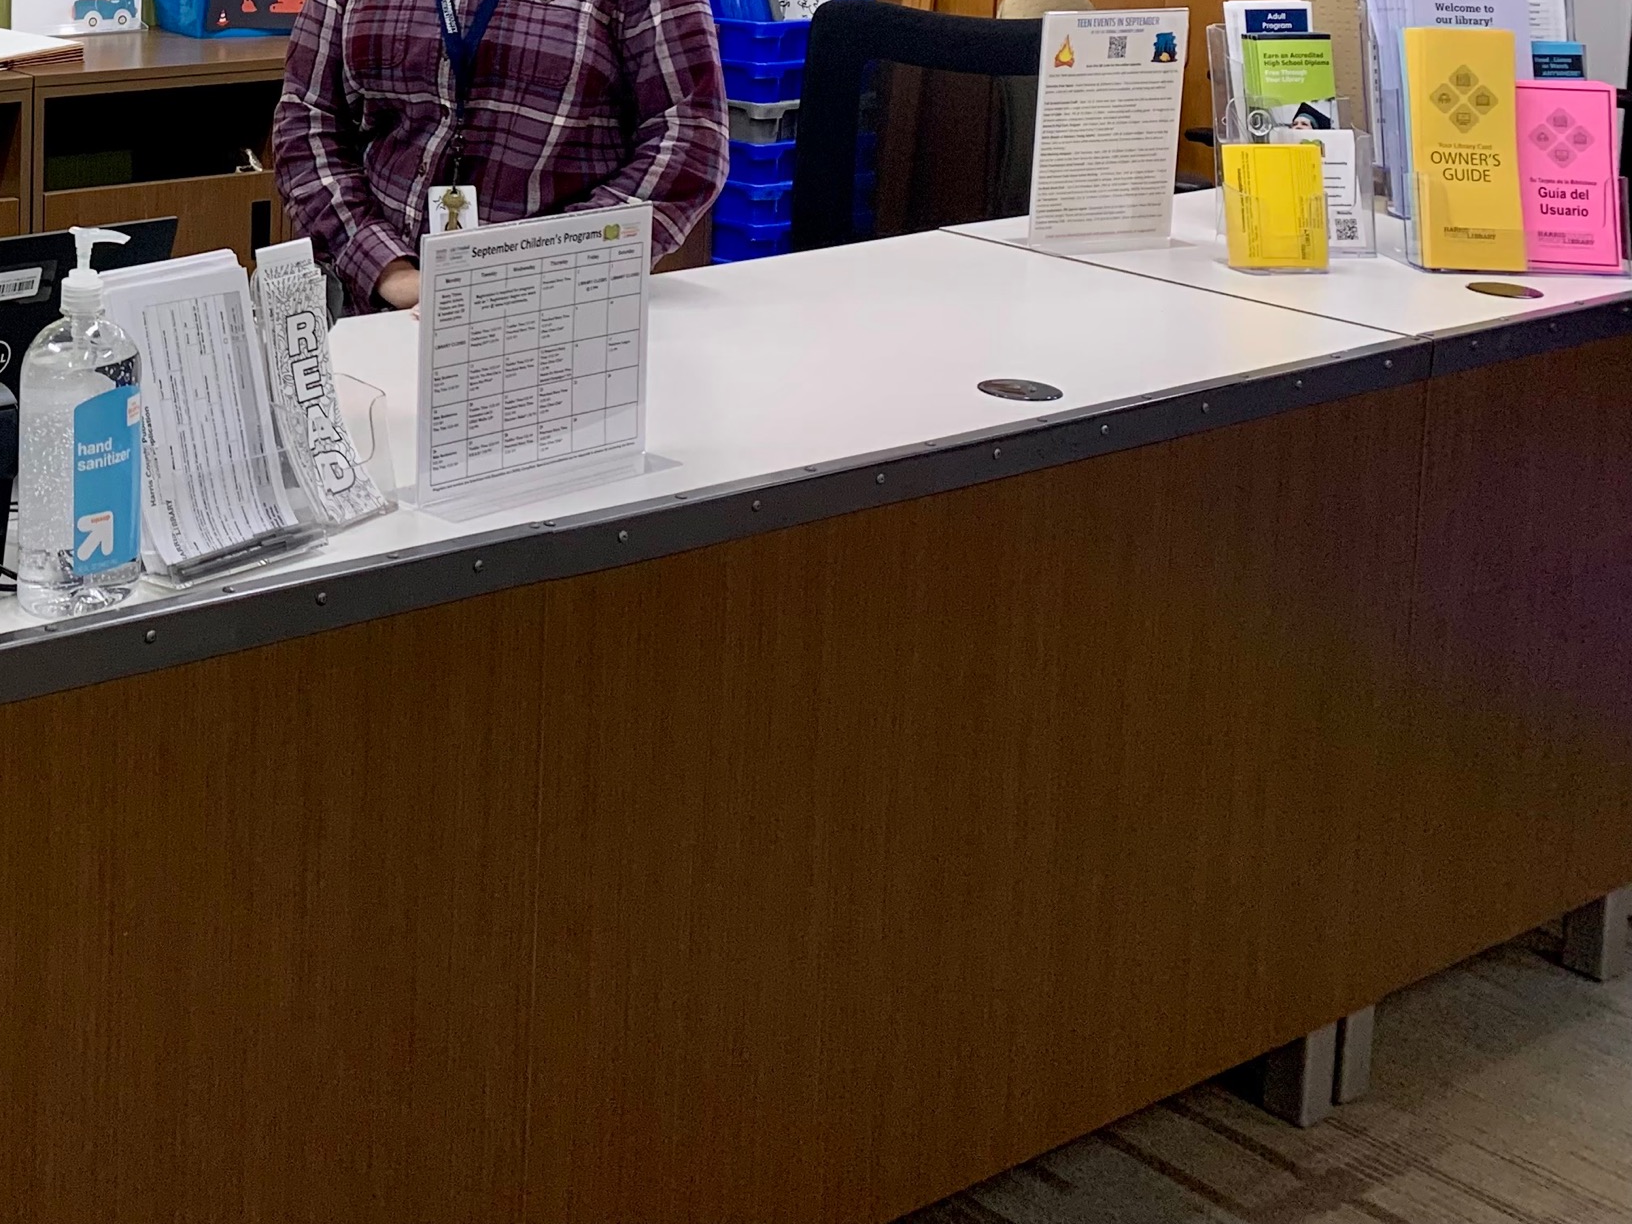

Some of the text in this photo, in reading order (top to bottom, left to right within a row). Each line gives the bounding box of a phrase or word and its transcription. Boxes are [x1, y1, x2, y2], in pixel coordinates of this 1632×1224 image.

[1435, 2, 1494, 13] Welcome to
[1077, 16, 1161, 28] TEEN EVENTS IN SEPTEMBER
[1262, 22, 1292, 30] Program
[1435, 15, 1493, 27] our library!
[1304, 59, 1330, 67] Diploma
[1430, 150, 1501, 167] OWNER'S
[1442, 167, 1491, 183] GUIDE
[1570, 188, 1589, 200] del
[1540, 203, 1589, 217] Usuario
[472, 242, 518, 259] September
[520, 234, 562, 250] Children's
[564, 229, 602, 244] Programs
[285, 310, 356, 495] READ
[77, 437, 113, 457] hand
[77, 448, 131, 472] sanitizer
[147, 478, 157, 508] Harris
[166, 499, 182, 541] LIBRARY
